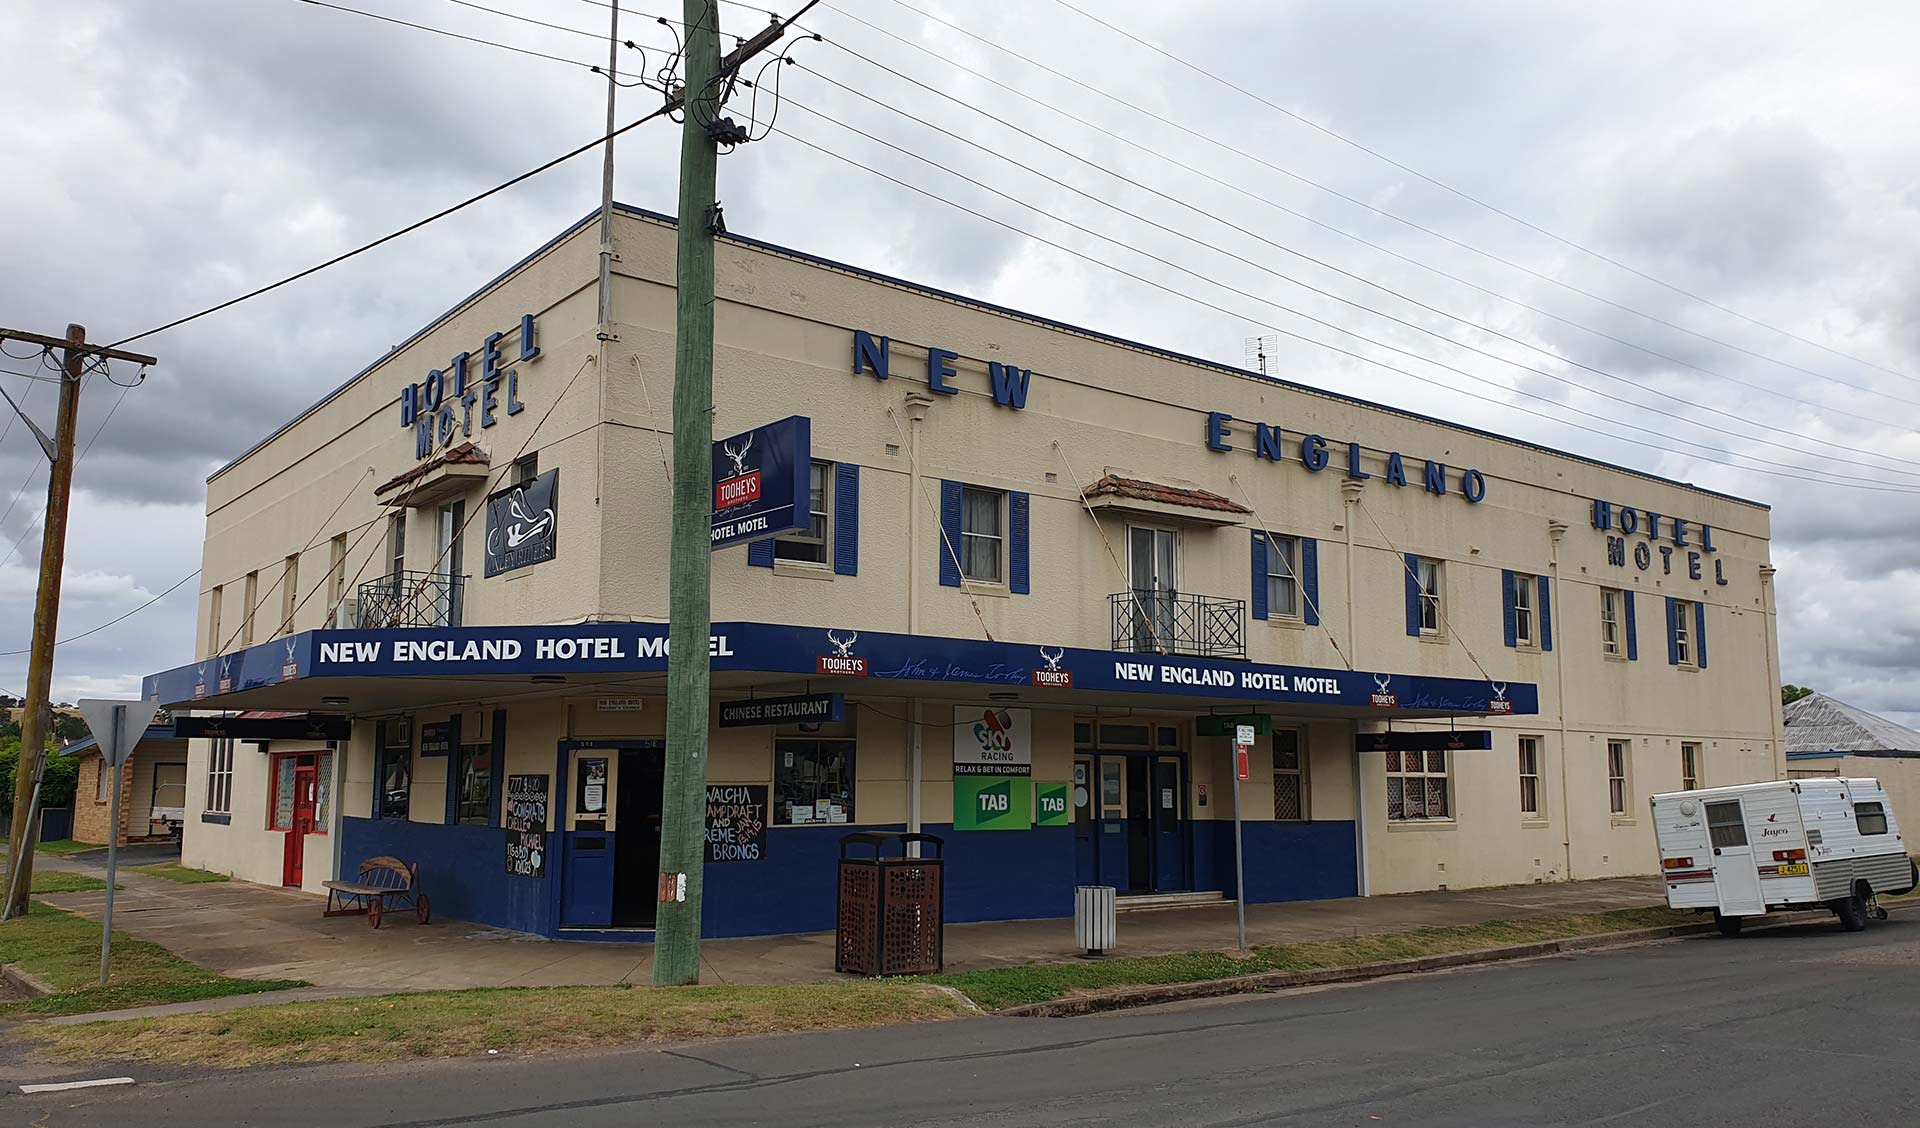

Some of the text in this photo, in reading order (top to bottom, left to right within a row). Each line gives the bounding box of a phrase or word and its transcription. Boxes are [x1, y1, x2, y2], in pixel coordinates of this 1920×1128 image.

[401, 314, 541, 428] HOTEL
[854, 340, 1032, 410] NEW
[415, 369, 525, 461] MOTEL
[721, 477, 756, 501] TOOHEYS
[737, 516, 769, 536] MOTEL
[1592, 499, 1718, 553] HOTEL
[1606, 535, 1729, 586] MOTEL
[319, 642, 381, 663] NEW
[393, 639, 522, 661] ENGLAND
[535, 638, 625, 660] HOTEL
[822, 657, 863, 671] TOOHEYS
[1036, 671, 1070, 684] TOOHEYS
[1115, 662, 1341, 695] NEW ENGLAND HOTEL MOTEL
[1371, 694, 1396, 704] TOOHEYS
[723, 700, 829, 720] CHINESE RESTAURANT
[977, 729, 1007, 747] SKY
[981, 752, 1014, 761] RACING
[955, 765, 1030, 774] RELAX & BET IN COMFORT
[705, 786, 751, 804] WALCHA
[979, 794, 1009, 811] TAB
[706, 804, 763, 819] AMPDRAFT
[1041, 798, 1065, 812] TAB
[712, 818, 731, 828] AND
[1761, 827, 1790, 837] Jayco
